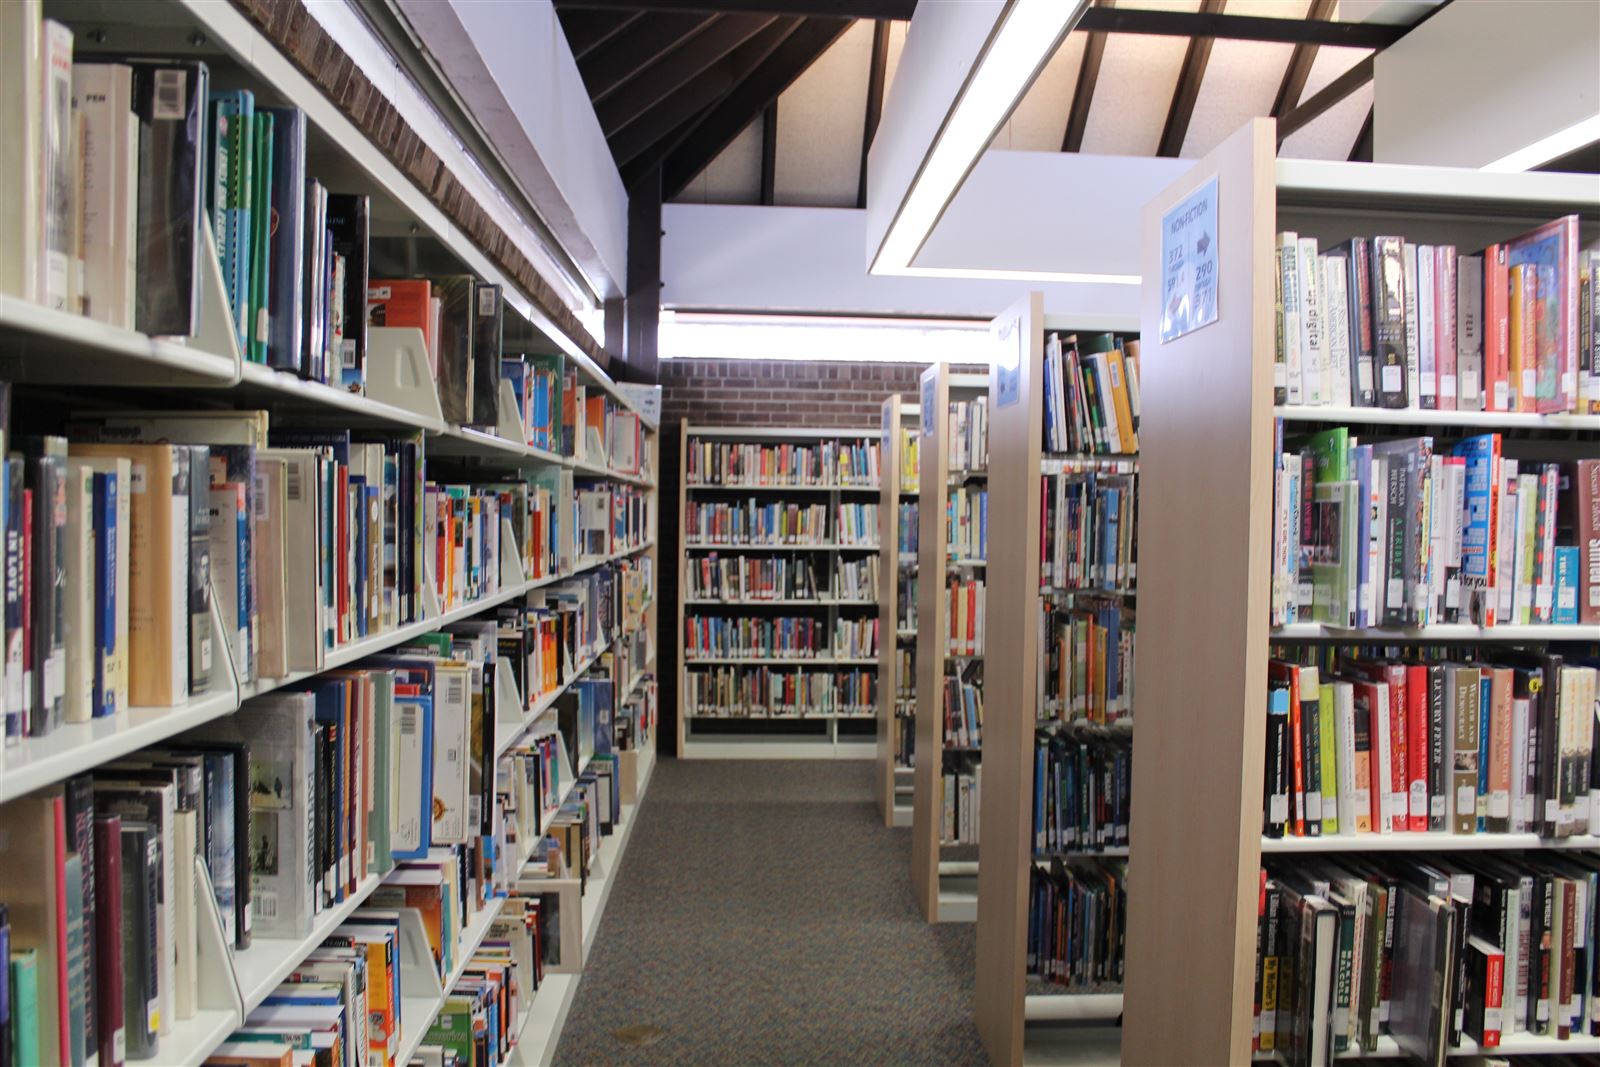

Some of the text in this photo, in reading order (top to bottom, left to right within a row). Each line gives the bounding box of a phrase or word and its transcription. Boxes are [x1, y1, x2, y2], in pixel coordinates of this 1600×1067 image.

[217, 147, 228, 258] LANDS AND PEOPLES
[1169, 244, 1183, 264] 372
[1196, 260, 1212, 280] 290
[1307, 310, 1319, 351] digital
[1394, 530, 1403, 563] TRIBE
[7, 530, 18, 602] IN LOVE
[1474, 576, 1487, 590] you
[1458, 686, 1467, 740] DEMOCRACY
[307, 772, 315, 885] EXPLORERS
[147, 838, 156, 866] ICE
